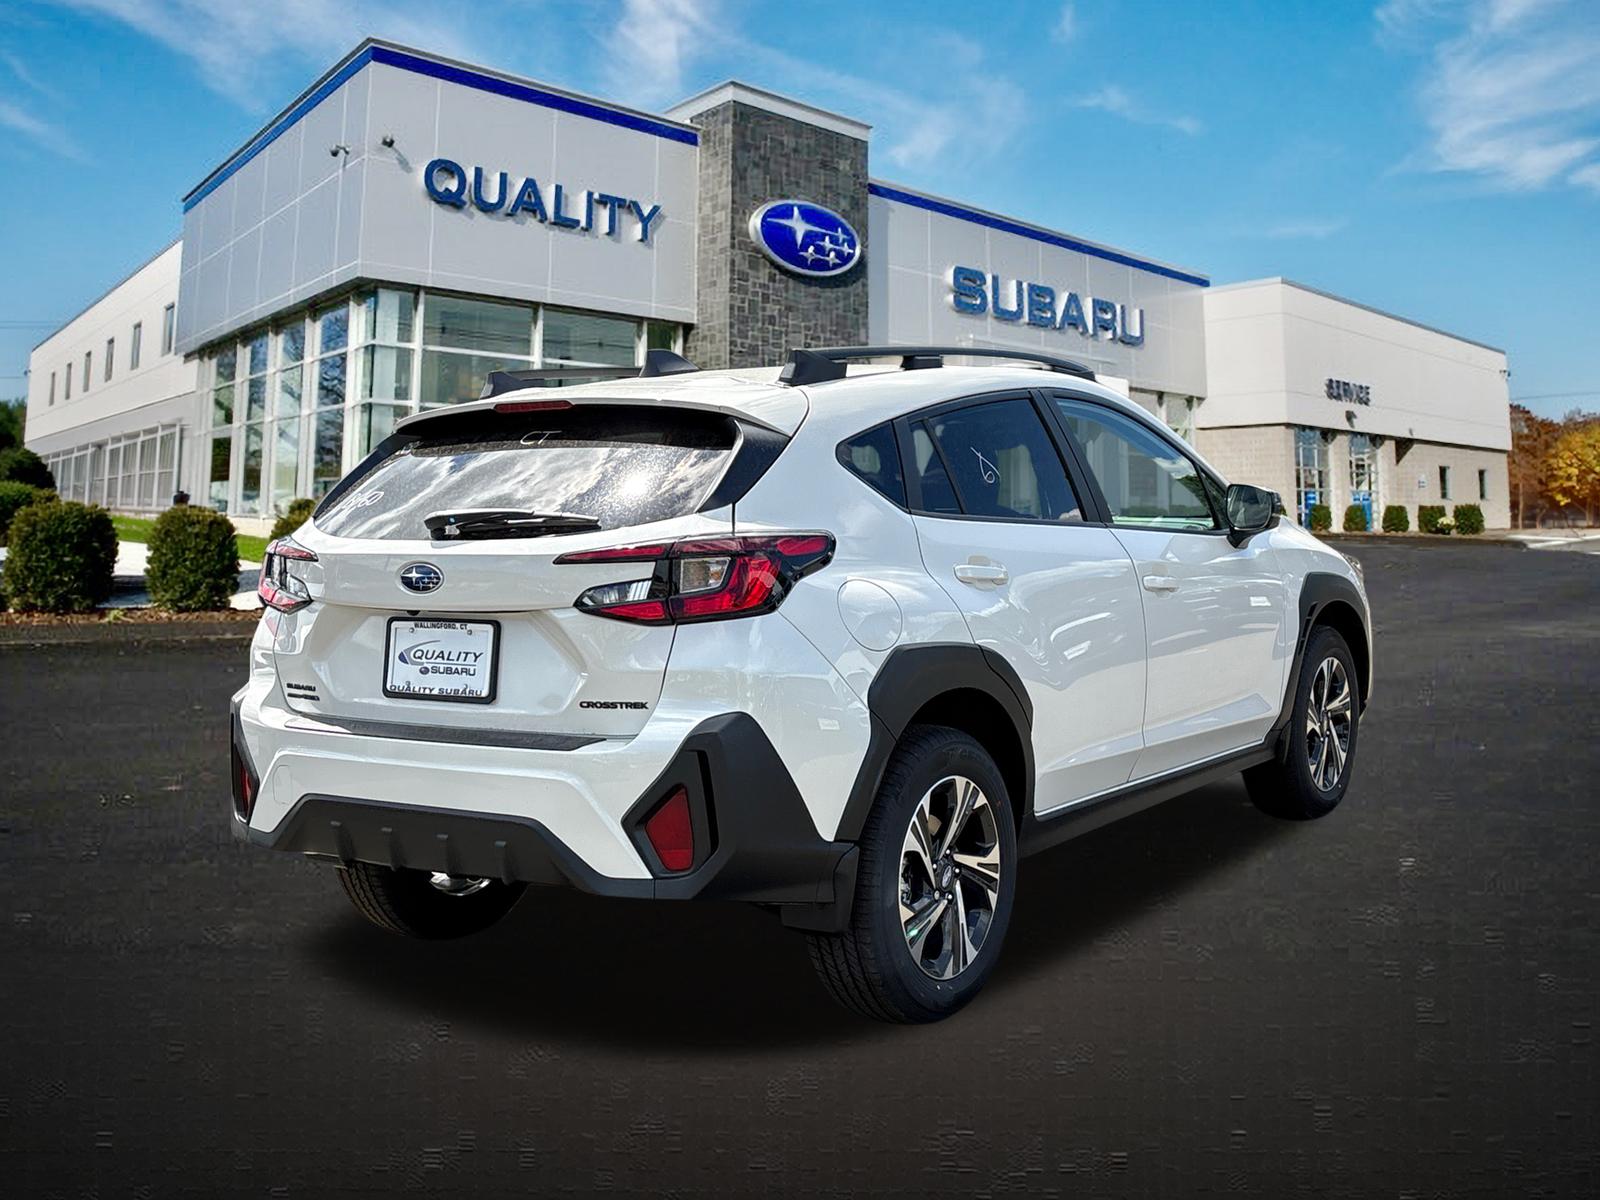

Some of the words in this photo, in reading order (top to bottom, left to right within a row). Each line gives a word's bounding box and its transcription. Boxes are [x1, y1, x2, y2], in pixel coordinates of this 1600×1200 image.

[424, 158, 661, 243] QUALITY
[950, 265, 1145, 346] SUBARU
[1324, 378, 1370, 406] SERVICE
[520, 430, 562, 445] CT
[412, 649, 483, 662] QUALITY
[430, 666, 476, 676] SUBARU
[389, 684, 436, 694] QUALITY
[437, 687, 483, 697] SUBARU
[579, 701, 649, 710] CROSSTREK
